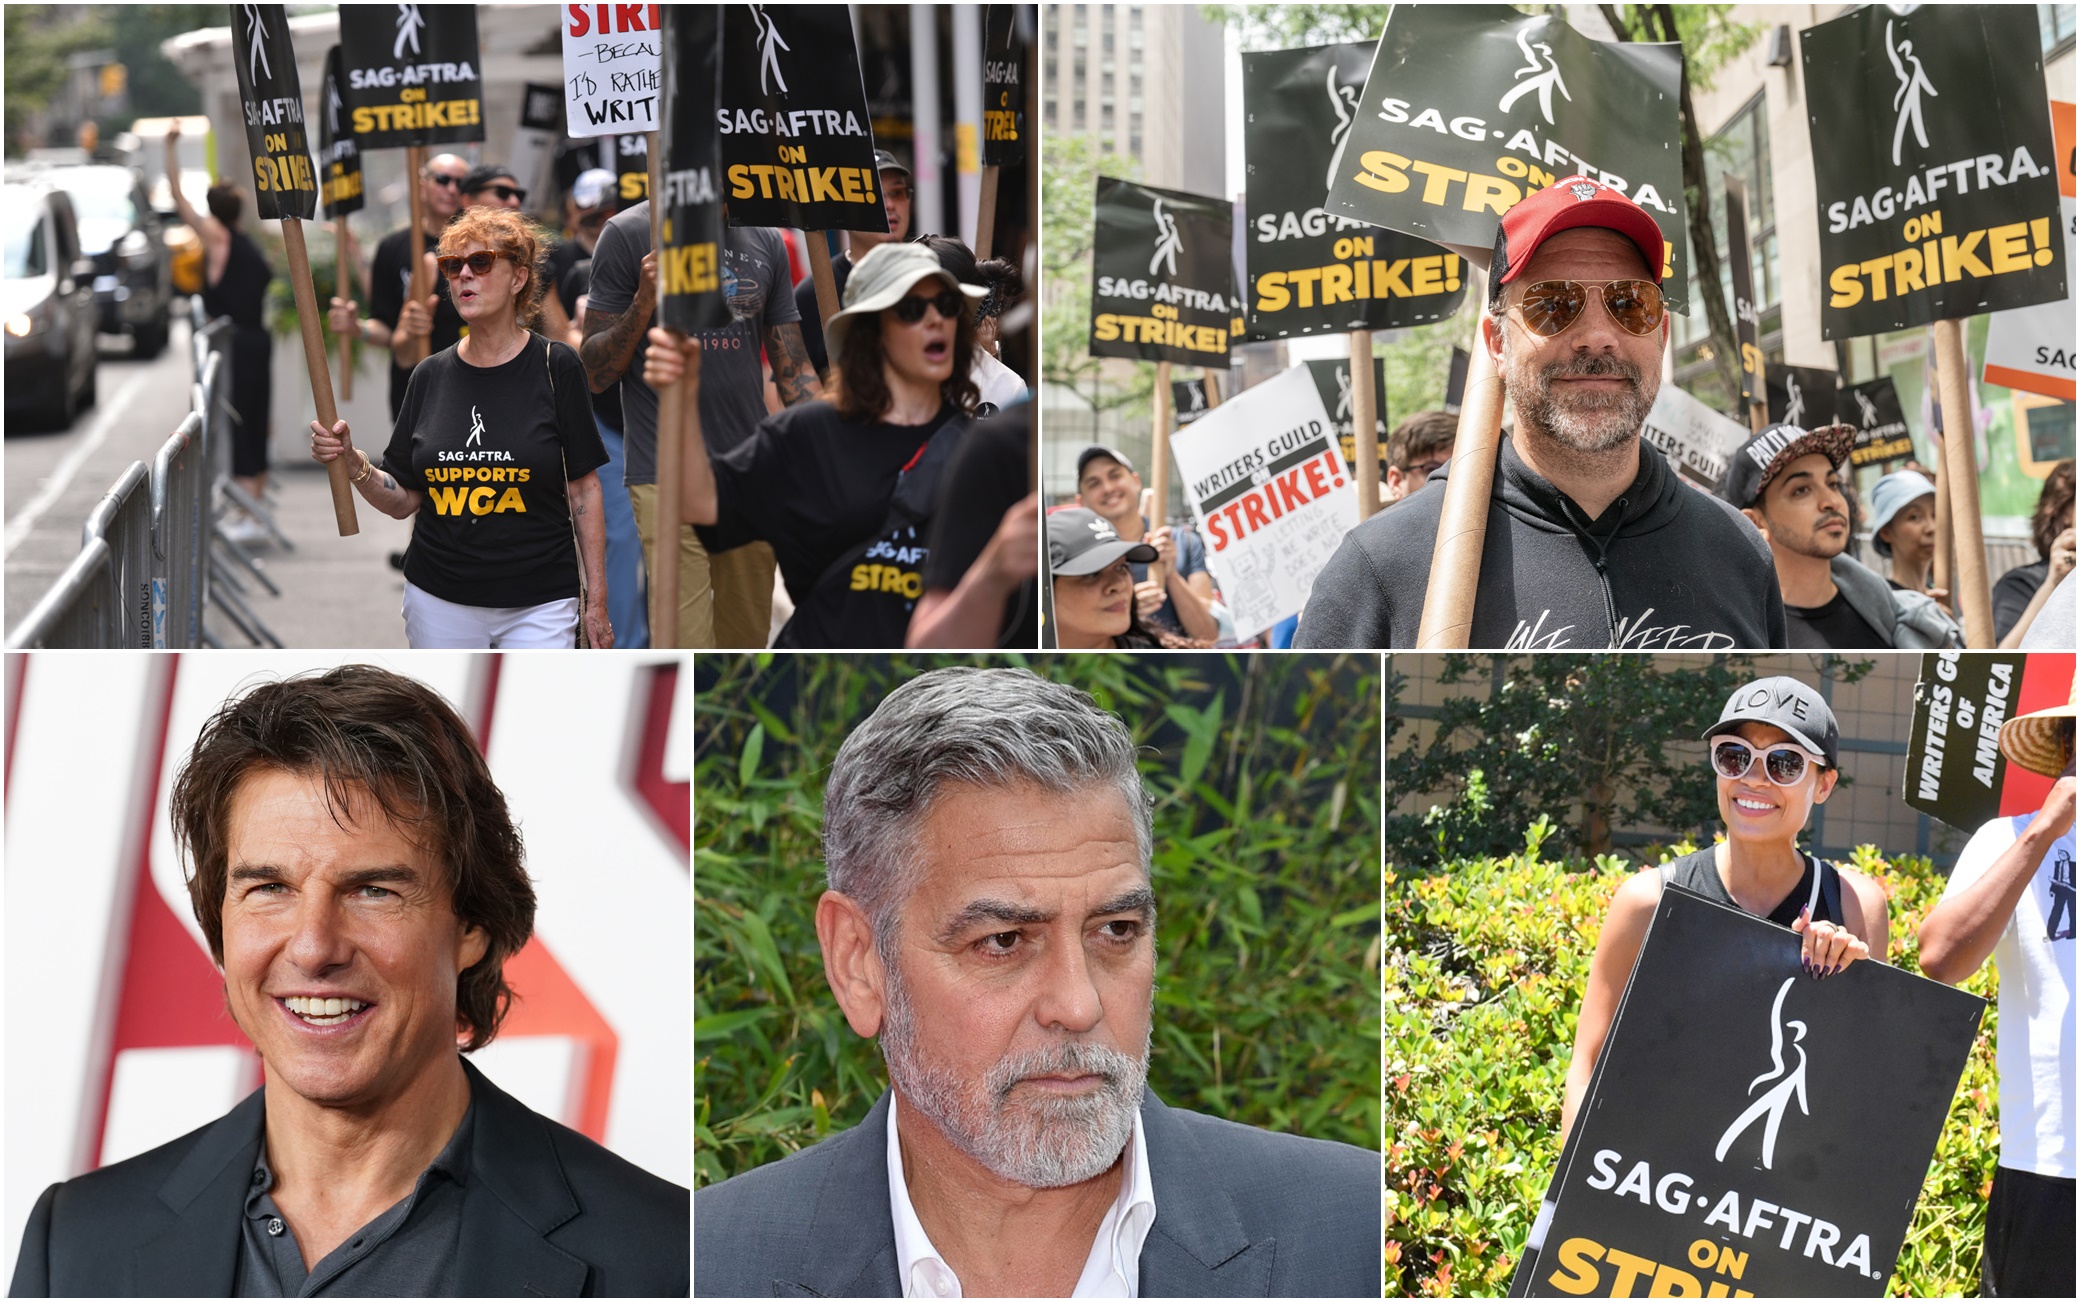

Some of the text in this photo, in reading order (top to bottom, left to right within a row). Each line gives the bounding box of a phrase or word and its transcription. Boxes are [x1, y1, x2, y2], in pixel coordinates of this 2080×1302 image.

[400, 87, 427, 104] ON
[584, 95, 660, 126] WRIT
[352, 99, 480, 133] STRIKE!
[264, 133, 288, 153] ON
[778, 145, 807, 164] ON
[728, 164, 877, 205] STRIKE!
[1496, 155, 1556, 189] ON
[1903, 210, 1943, 243] ON
[1333, 236, 1375, 260] ON
[1829, 217, 2054, 308] STRIKE!
[1256, 253, 1461, 312] STRIKE!
[1151, 303, 1179, 321] ON
[703, 337, 741, 351] 1980
[1094, 313, 1228, 354] STRIKE!
[424, 467, 531, 483] SUPPORTS
[1194, 448, 1264, 498] WRITERS
[1268, 420, 1323, 457] GUILD
[428, 486, 527, 517] WGA
[1207, 450, 1345, 551] STRIKE!
[1734, 687, 1810, 722] LOVE
[1956, 696, 1976, 729] OF
[1918, 684, 1953, 801] WRITERS
[1972, 663, 2013, 789] AMERICA
[1688, 1238, 1750, 1280] ON
